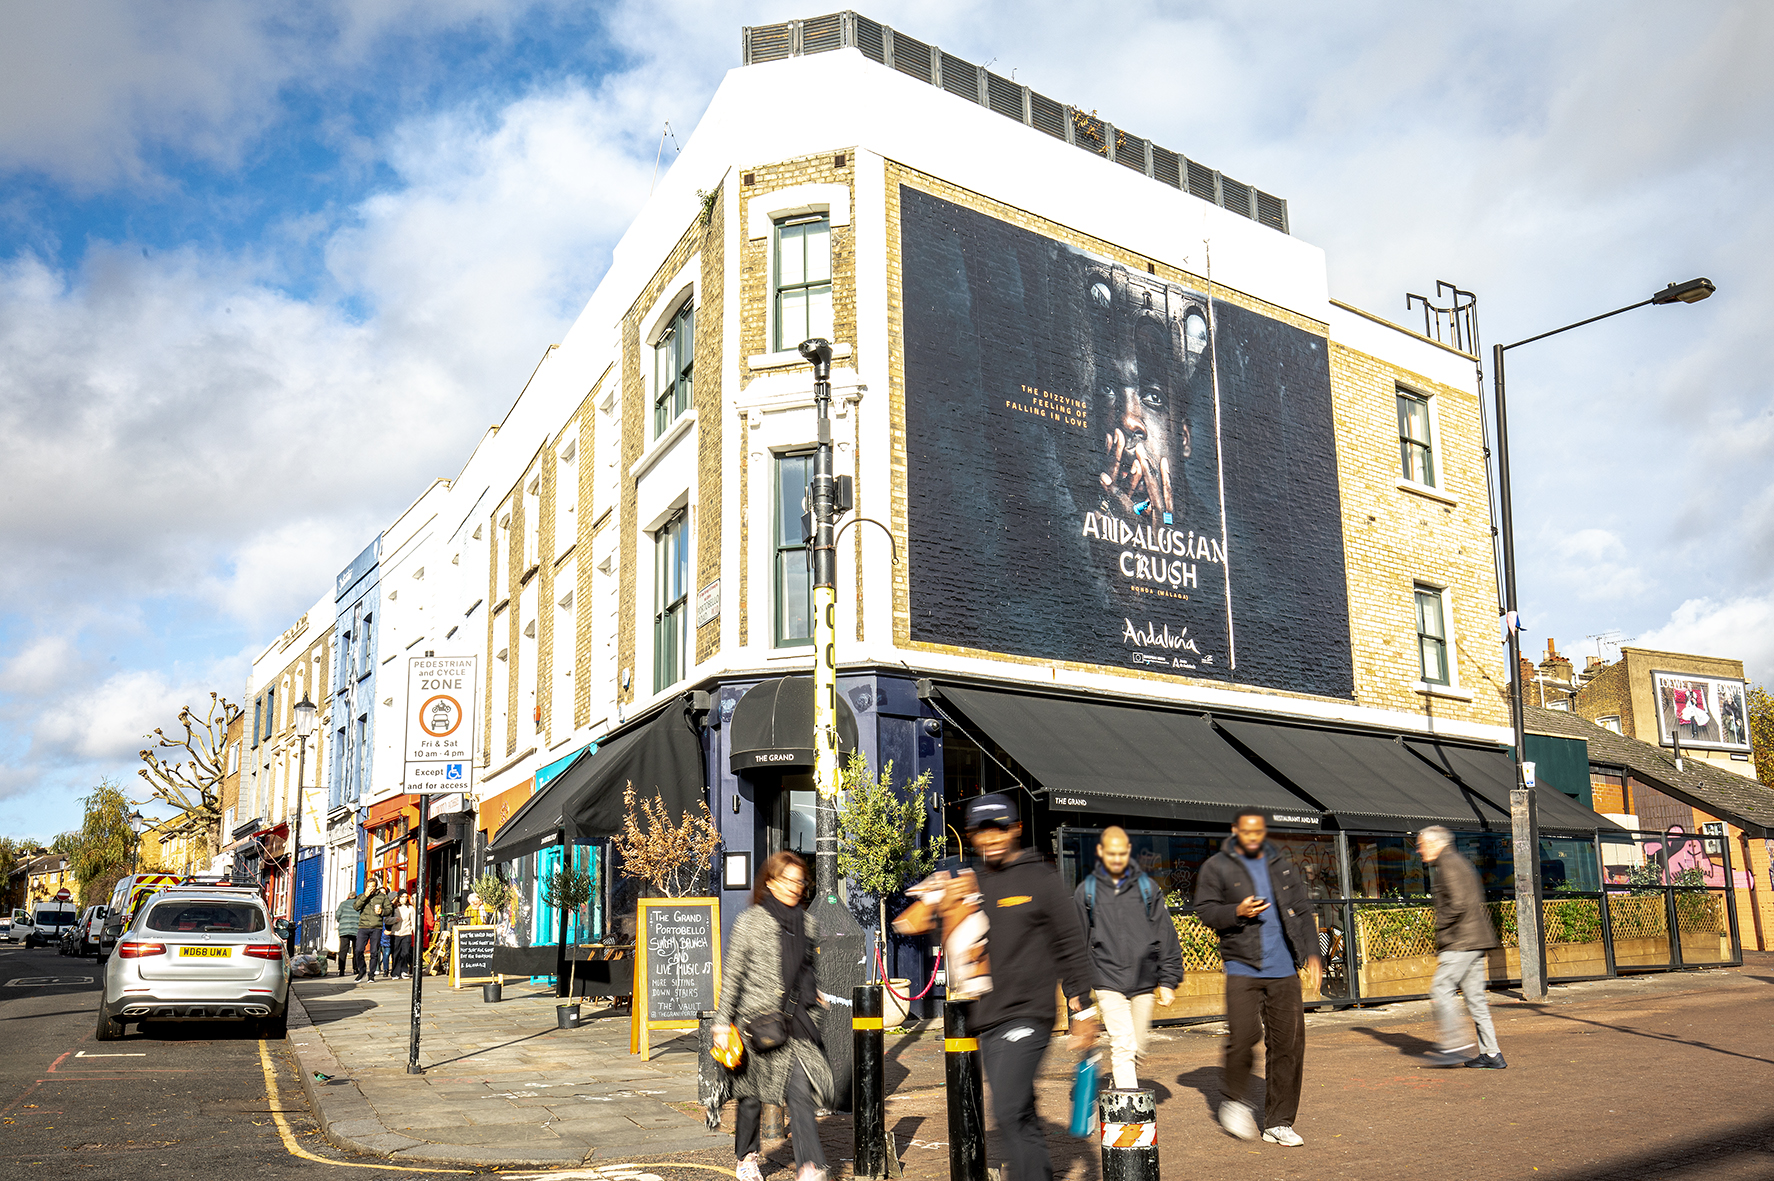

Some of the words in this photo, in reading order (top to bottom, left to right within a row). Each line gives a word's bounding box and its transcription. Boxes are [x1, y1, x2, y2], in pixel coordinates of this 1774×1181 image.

[1021, 384, 1039, 396] THE
[1043, 390, 1087, 409] DIZZYING
[1033, 397, 1072, 415] FEELING
[1076, 409, 1087, 419] OF
[1006, 400, 1046, 417] FALLING
[1050, 411, 1060, 421] IN
[1064, 416, 1088, 429] LOVE
[1119, 551, 1198, 589] CRUSH
[1121, 617, 1201, 655] Andalucía
[413, 660, 472, 669] PEDESTRIAN
[418, 669, 434, 677] and
[436, 668, 466, 677] CYCLE
[421, 679, 462, 690] ZONE
[1660, 677, 1687, 689] LOEWE
[451, 751, 465, 759] pm
[755, 754, 768, 763] THE
[768, 753, 795, 762] GRAND
[415, 769, 444, 777] Except
[407, 782, 423, 790] and
[440, 782, 468, 790] access
[1055, 797, 1067, 805] THE
[1067, 797, 1087, 806] GRAND
[655, 923, 706, 935] PORTOBELLO
[183, 947, 208, 956] WD68
[209, 948, 228, 956] UWA
[656, 963, 672, 975] LIVE
[676, 963, 700, 975] MUSIC
[651, 979, 667, 987] MORE
[651, 988, 671, 997] DOWN
[674, 988, 698, 998] STAIRS
[657, 1002, 672, 1011] THE
[678, 1002, 702, 1011] VAULT
